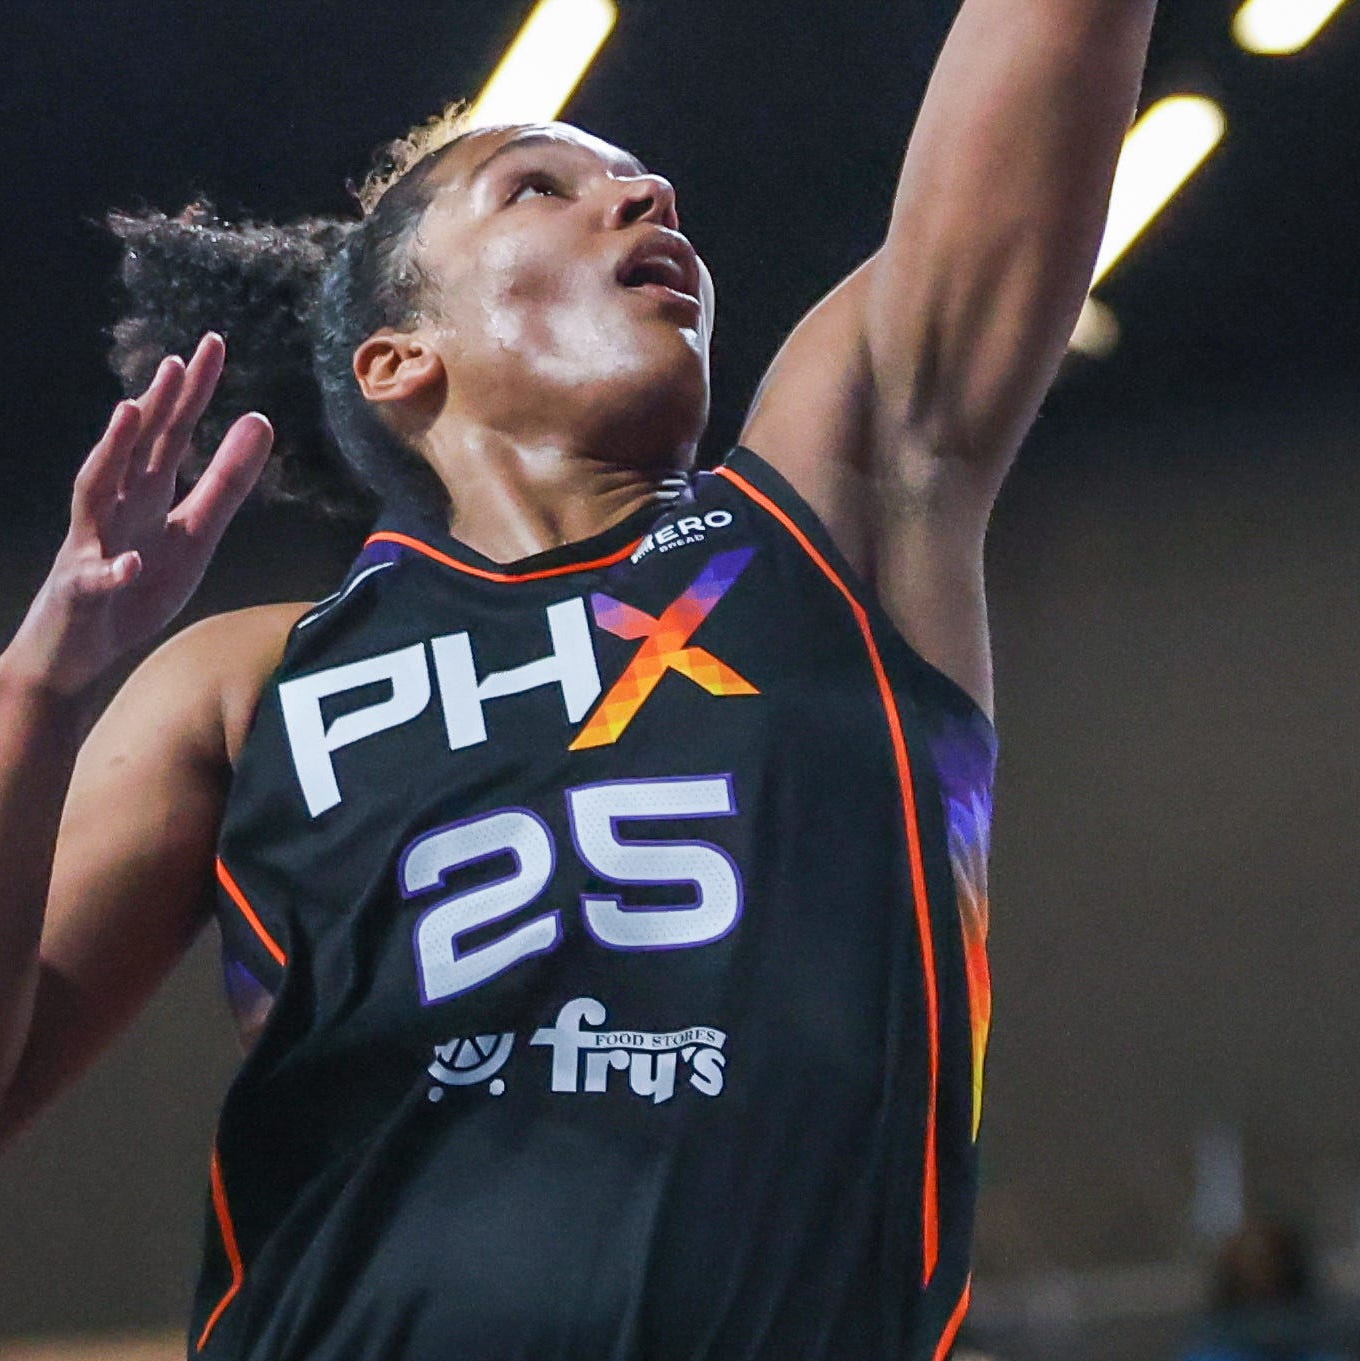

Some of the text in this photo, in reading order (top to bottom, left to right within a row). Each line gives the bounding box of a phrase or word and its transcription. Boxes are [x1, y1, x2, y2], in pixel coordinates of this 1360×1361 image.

[277, 546, 761, 818] PHX
[397, 773, 745, 1007] 25
[530, 997, 727, 1104] fry's
[595, 1029, 717, 1048] FOOD STORES
